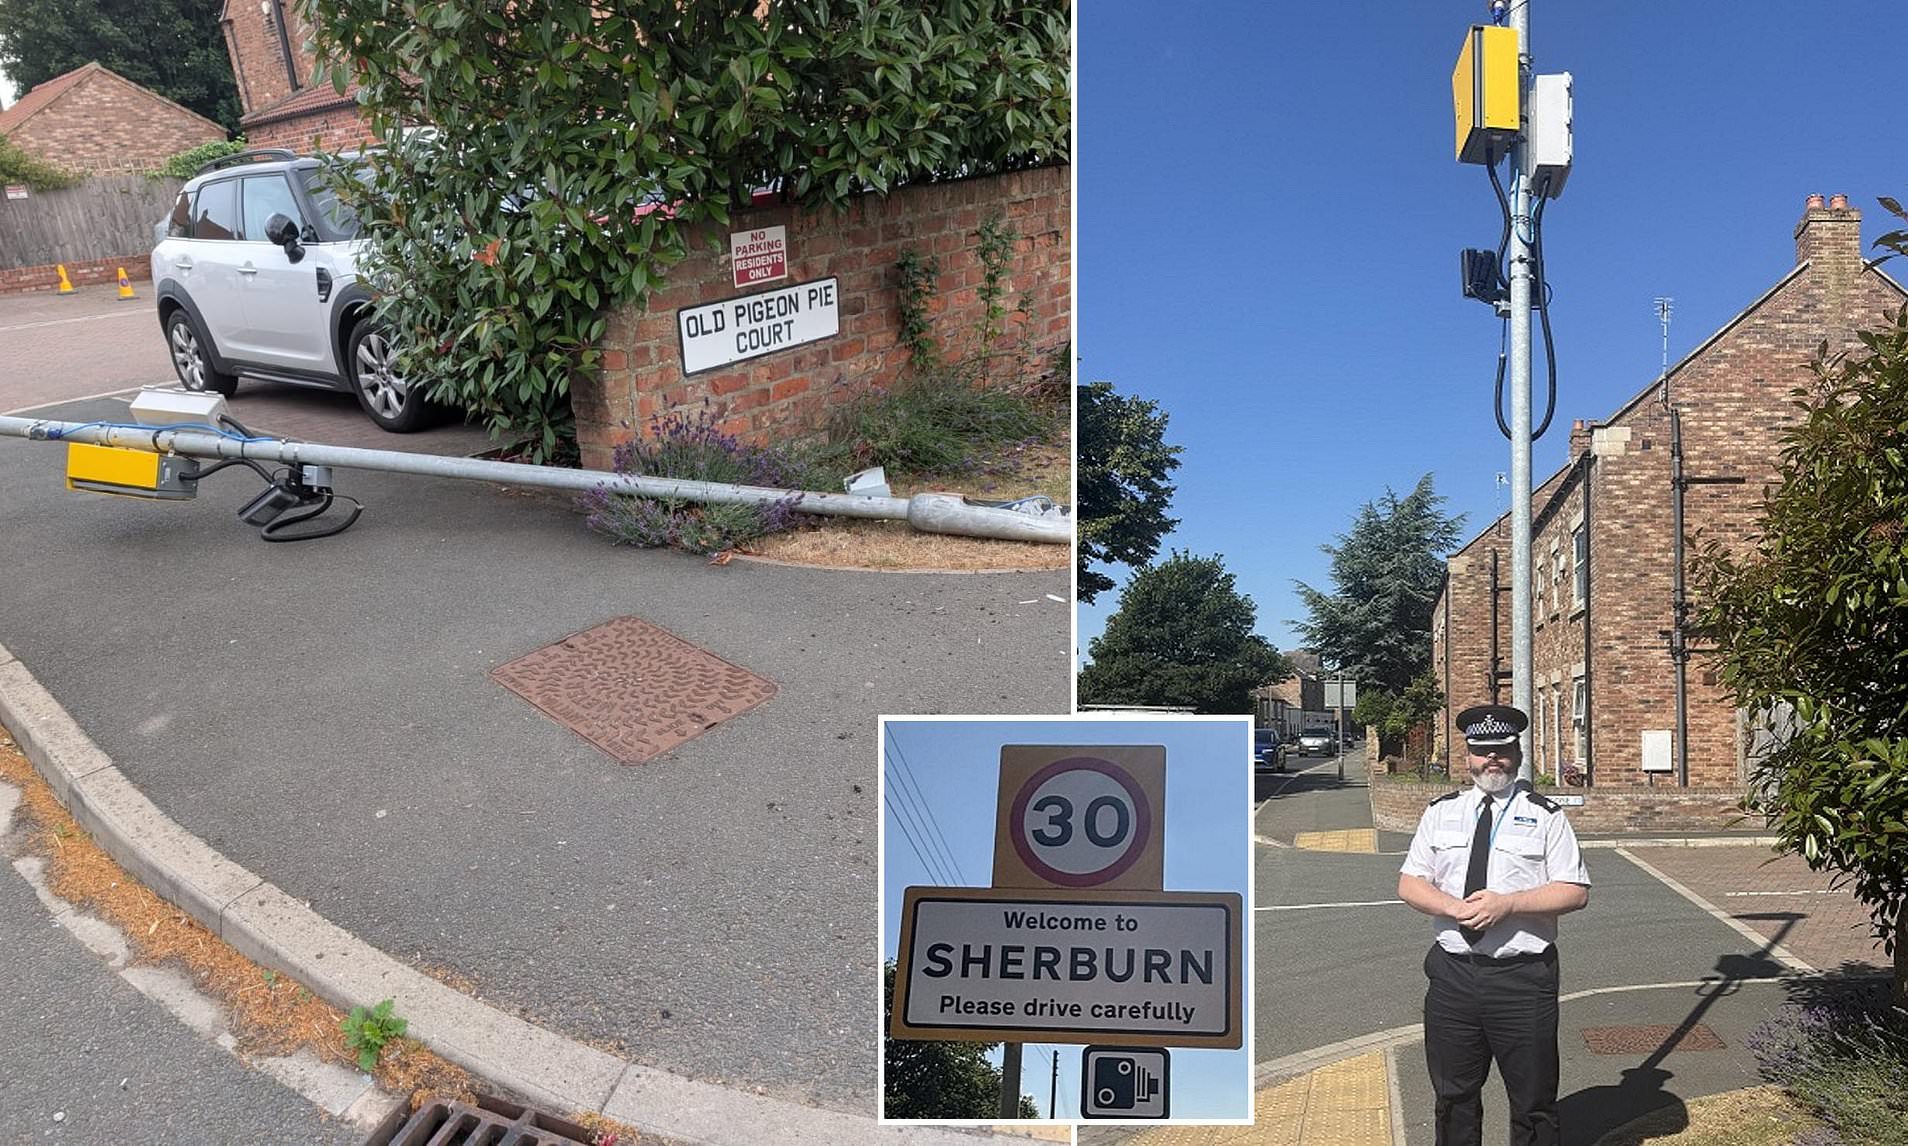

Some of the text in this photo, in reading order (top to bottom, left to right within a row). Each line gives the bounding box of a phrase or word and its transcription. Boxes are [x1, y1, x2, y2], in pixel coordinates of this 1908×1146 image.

[735, 239, 782, 256] PARKING
[750, 231, 766, 242] NO
[735, 252, 784, 270] RESIDENTS
[748, 266, 772, 280] ONLY
[686, 285, 834, 338] OLD PIGEON PIE
[736, 319, 794, 354] COURT
[1031, 795, 1130, 848] 30
[1004, 911, 1138, 931] Welcome to
[922, 943, 1213, 985] SHERBURN
[939, 995, 1195, 1024] Please drive carefully
